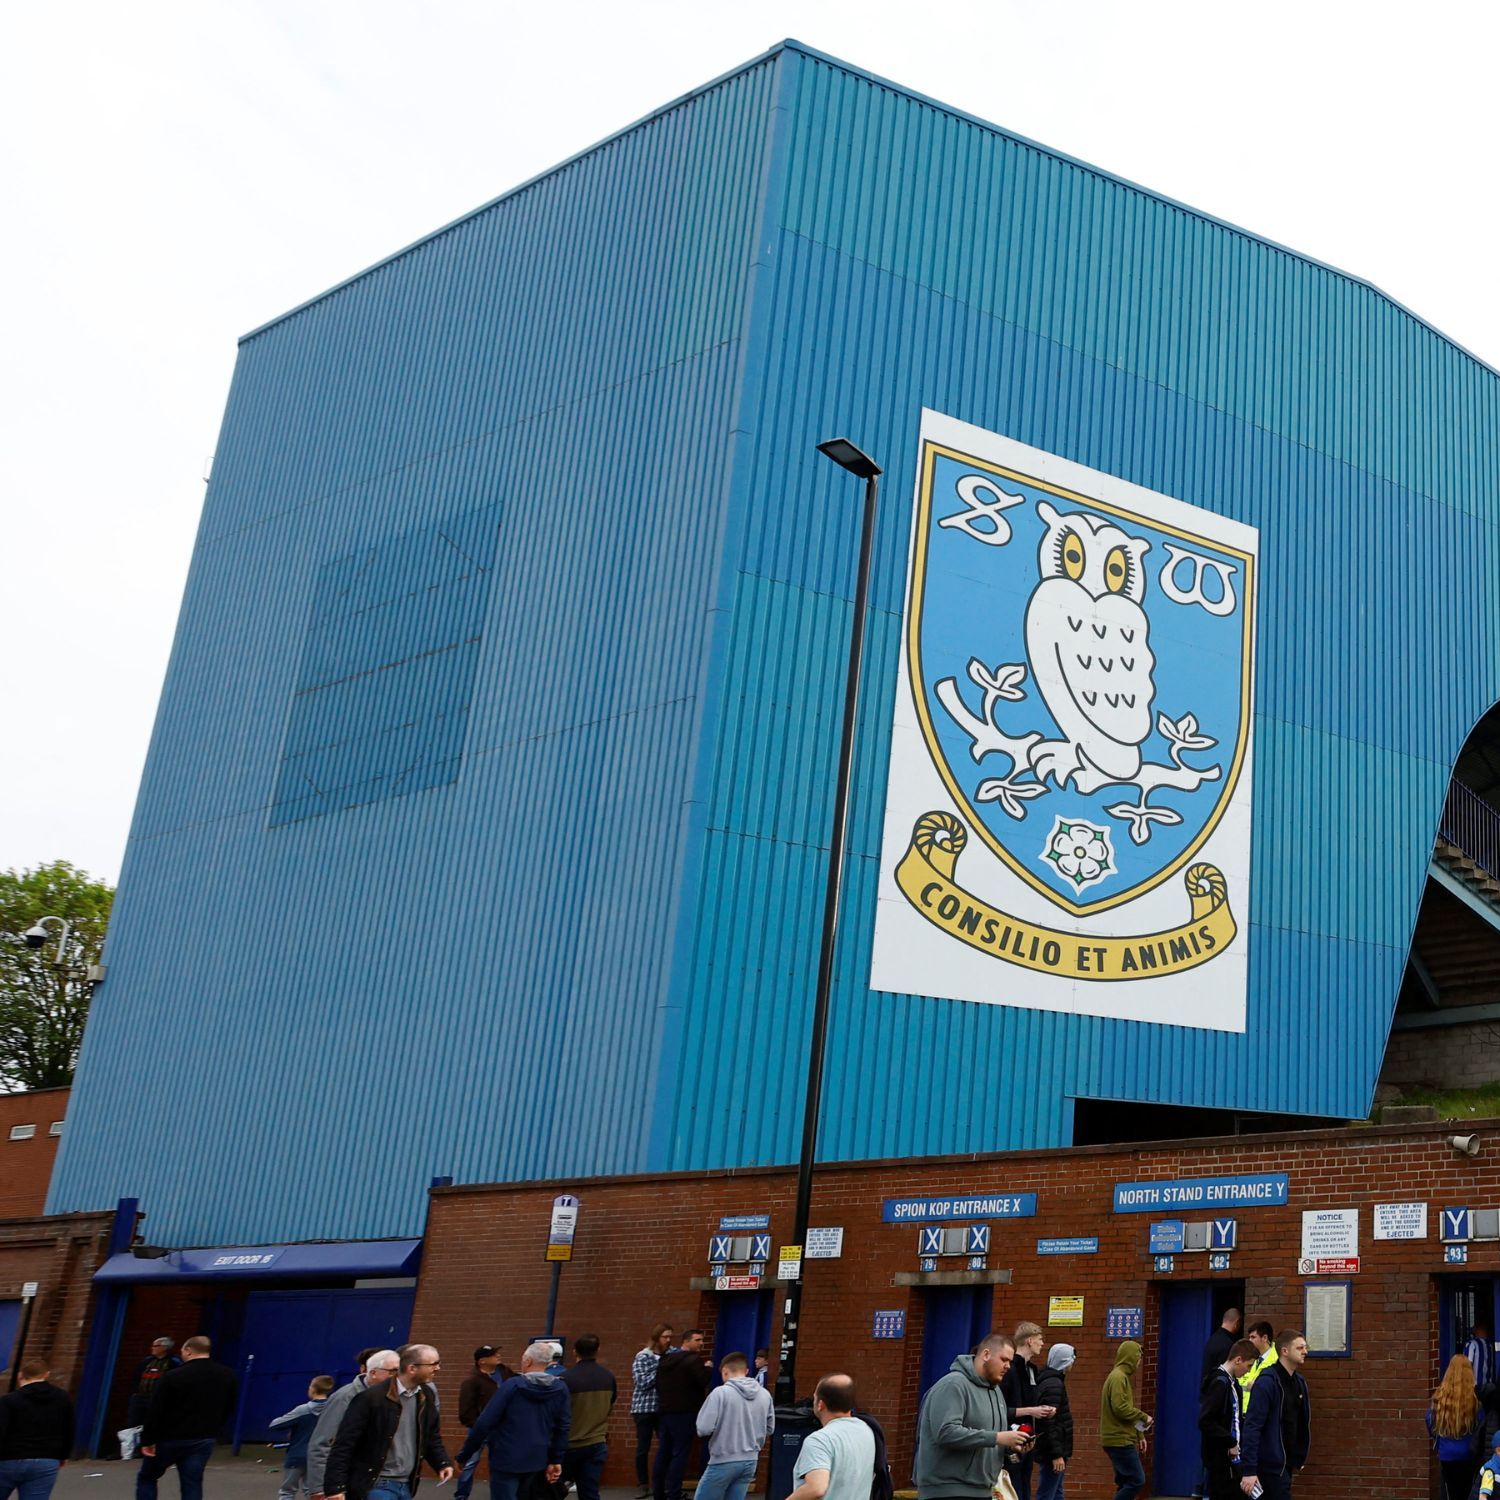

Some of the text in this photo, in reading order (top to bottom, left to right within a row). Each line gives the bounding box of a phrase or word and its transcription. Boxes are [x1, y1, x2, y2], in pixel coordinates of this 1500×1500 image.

[921, 882, 1216, 972] CONSILIO ET ANIMIS
[1119, 1182, 1285, 1205] NORTH STAND ENTRANCE Y
[894, 1198, 1021, 1218] SPION KOP ENTRANCE X
[1216, 1221, 1232, 1245] Y
[1446, 1210, 1466, 1236] Y
[714, 1237, 728, 1258] X
[754, 1236, 768, 1257] X
[925, 1228, 940, 1250] X
[971, 1227, 986, 1249] X
[213, 1256, 237, 1265] EXIT
[233, 1255, 262, 1264] DOOR
[714, 1266, 722, 1275] 77
[924, 1259, 933, 1269] 79
[972, 1257, 982, 1268] 80
